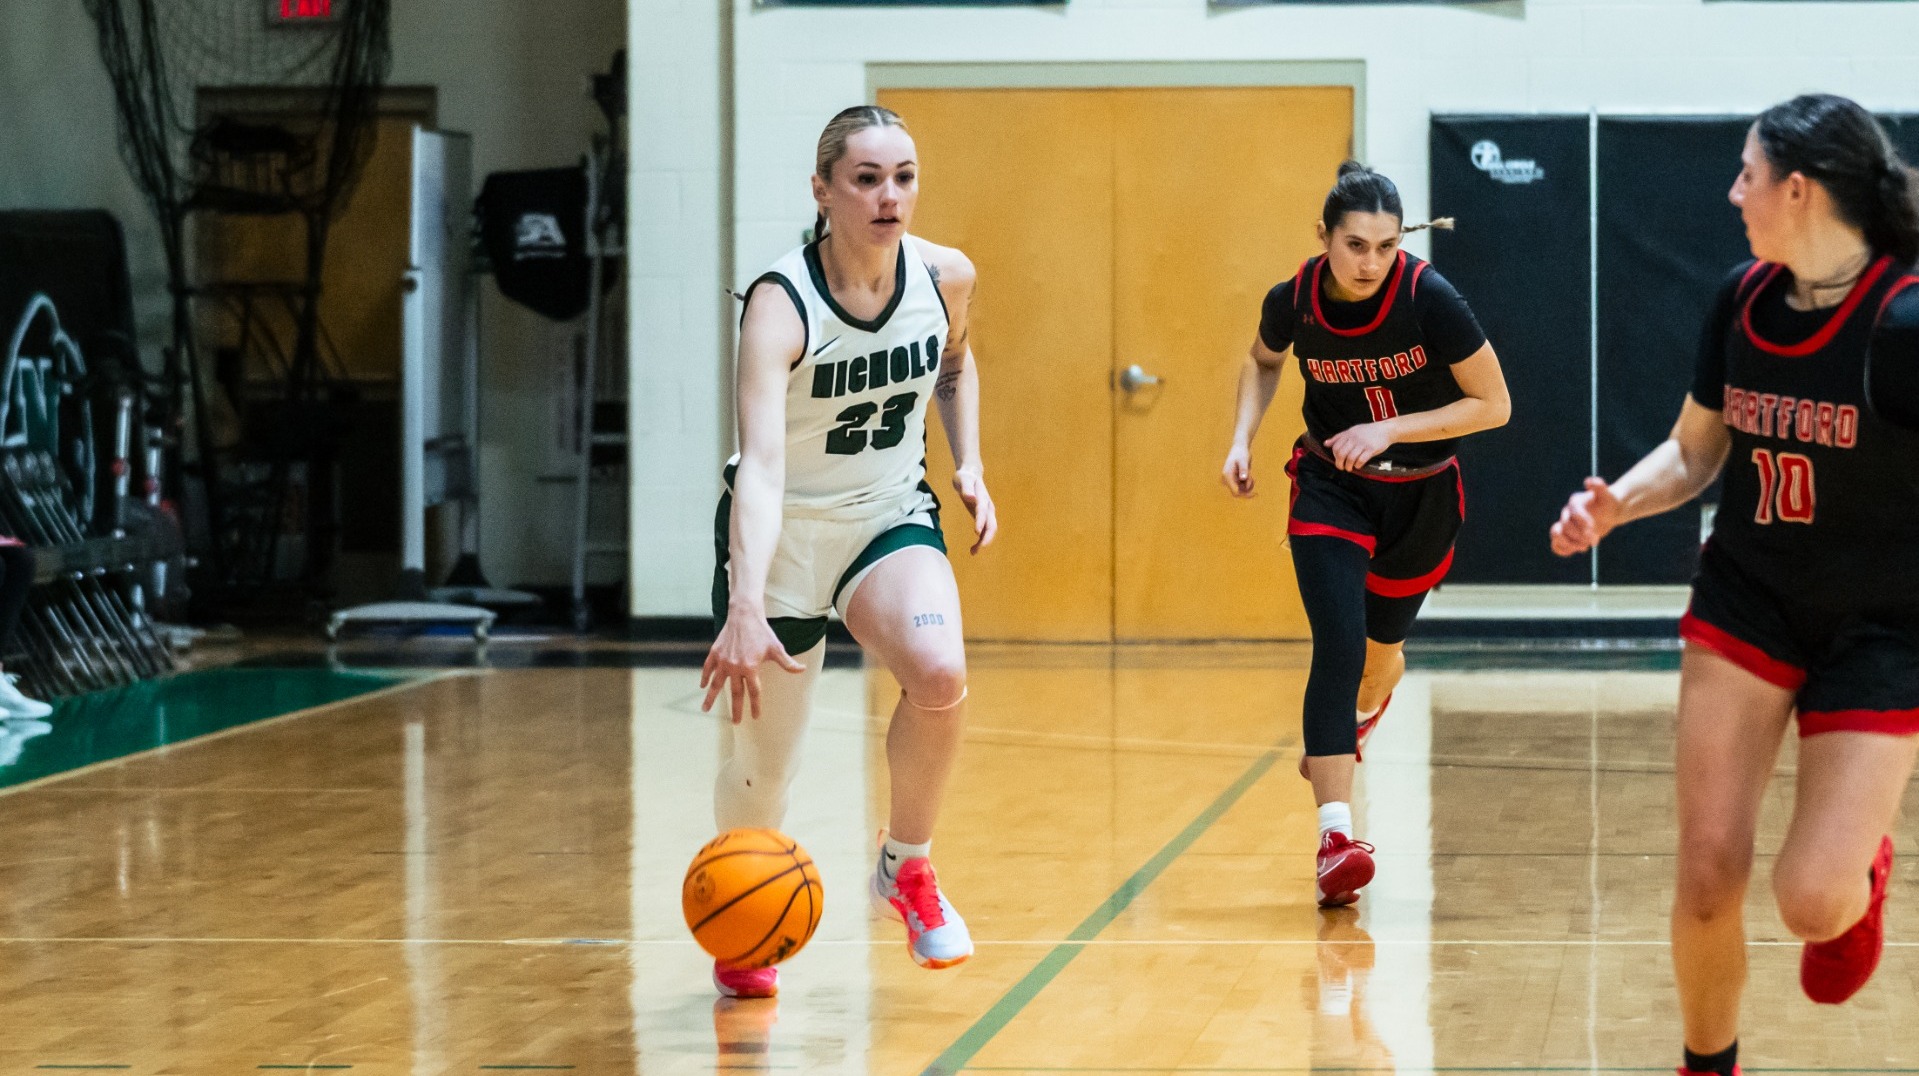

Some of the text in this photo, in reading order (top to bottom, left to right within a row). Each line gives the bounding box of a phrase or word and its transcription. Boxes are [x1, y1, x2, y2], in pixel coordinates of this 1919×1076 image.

[811, 334, 939, 398] NICHOLS
[1307, 345, 1428, 384] HARTFORD
[825, 391, 918, 455] 23
[1751, 447, 1817, 525] 10
